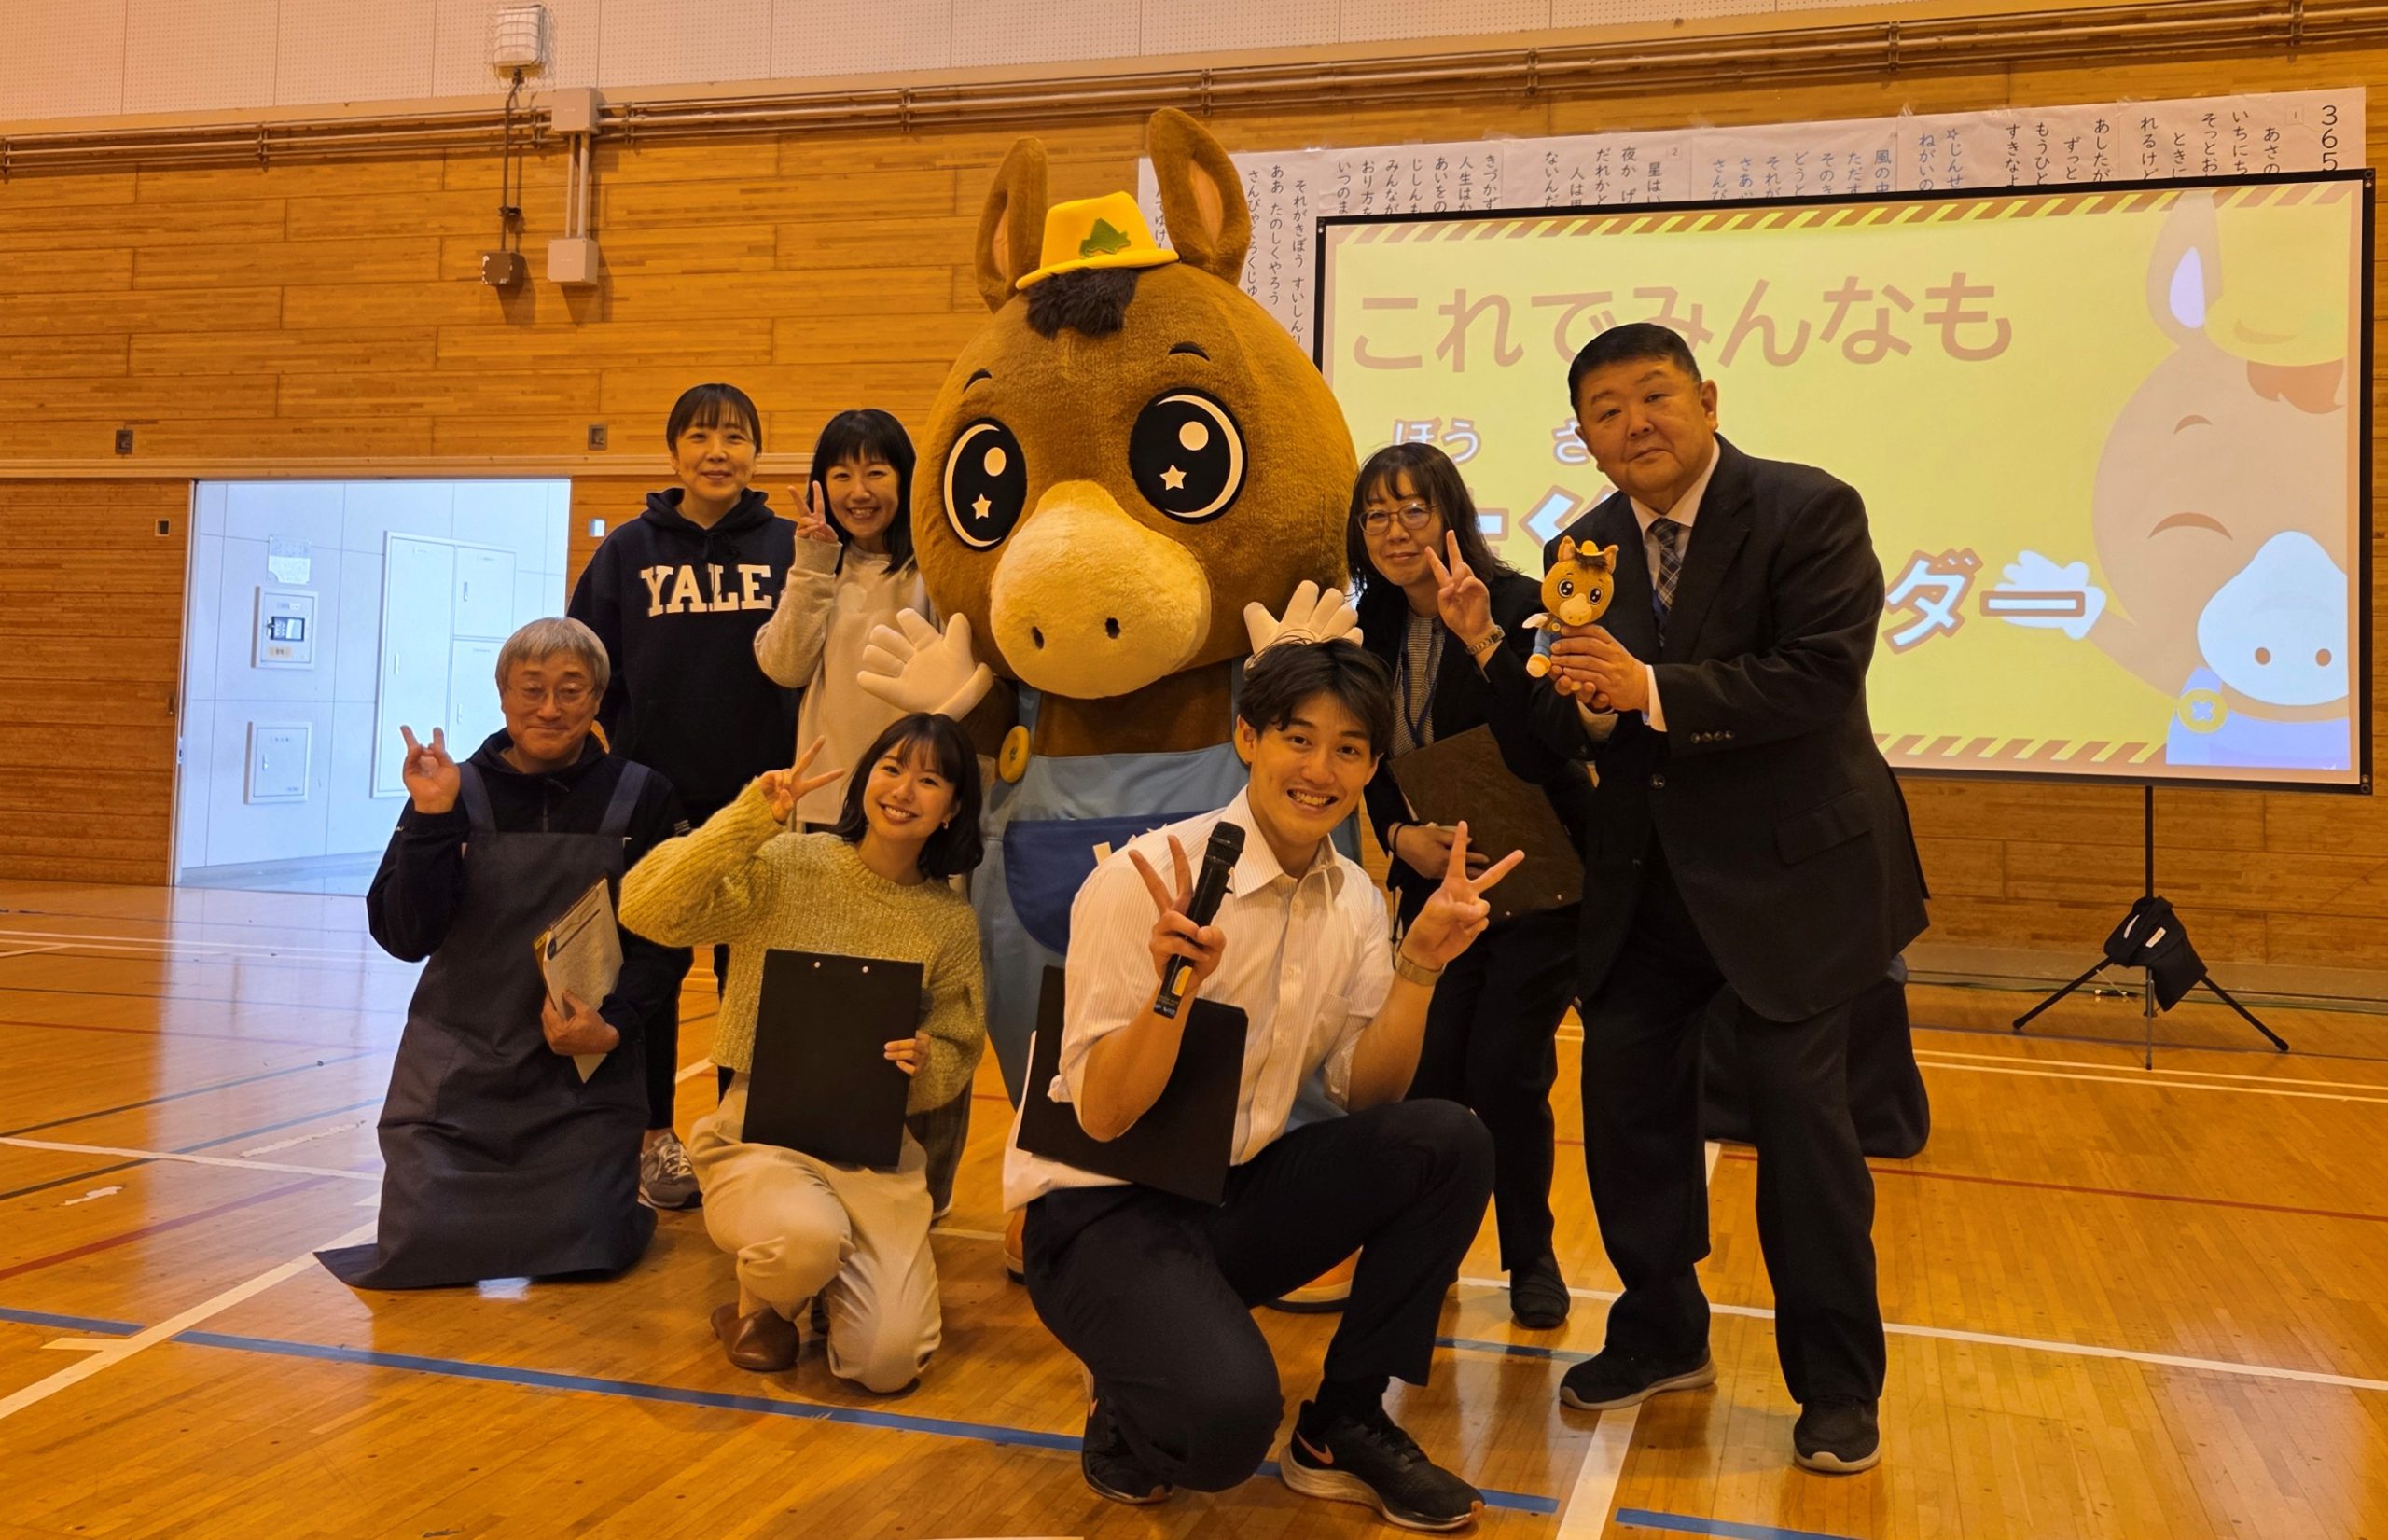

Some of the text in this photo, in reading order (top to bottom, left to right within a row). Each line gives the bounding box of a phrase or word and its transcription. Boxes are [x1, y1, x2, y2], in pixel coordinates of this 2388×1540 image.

[1918, 133, 1936, 192] ねがいの
[2035, 121, 2050, 186] もうひと
[2063, 136, 2081, 181] ずっと
[2092, 118, 2110, 182] あしたが
[2201, 112, 2218, 177] そっとお
[2232, 110, 2249, 175] いちにち
[2263, 126, 2280, 174] あさの
[2321, 104, 2338, 172] 365
[1336, 160, 1352, 215] いつのま
[1433, 156, 1449, 213] あいをの
[1482, 154, 1501, 210] きづかず
[1544, 151, 1560, 208] ないんだ
[1595, 147, 1612, 205] だれかと
[1646, 161, 1662, 203] 星はい
[1793, 149, 1809, 196] どうと
[1874, 148, 1892, 194] 風の中
[1269, 164, 1284, 306] ああ たのしくやろう
[1353, 271, 2013, 373] これでみんなも
[640, 562, 773, 617] YALE
